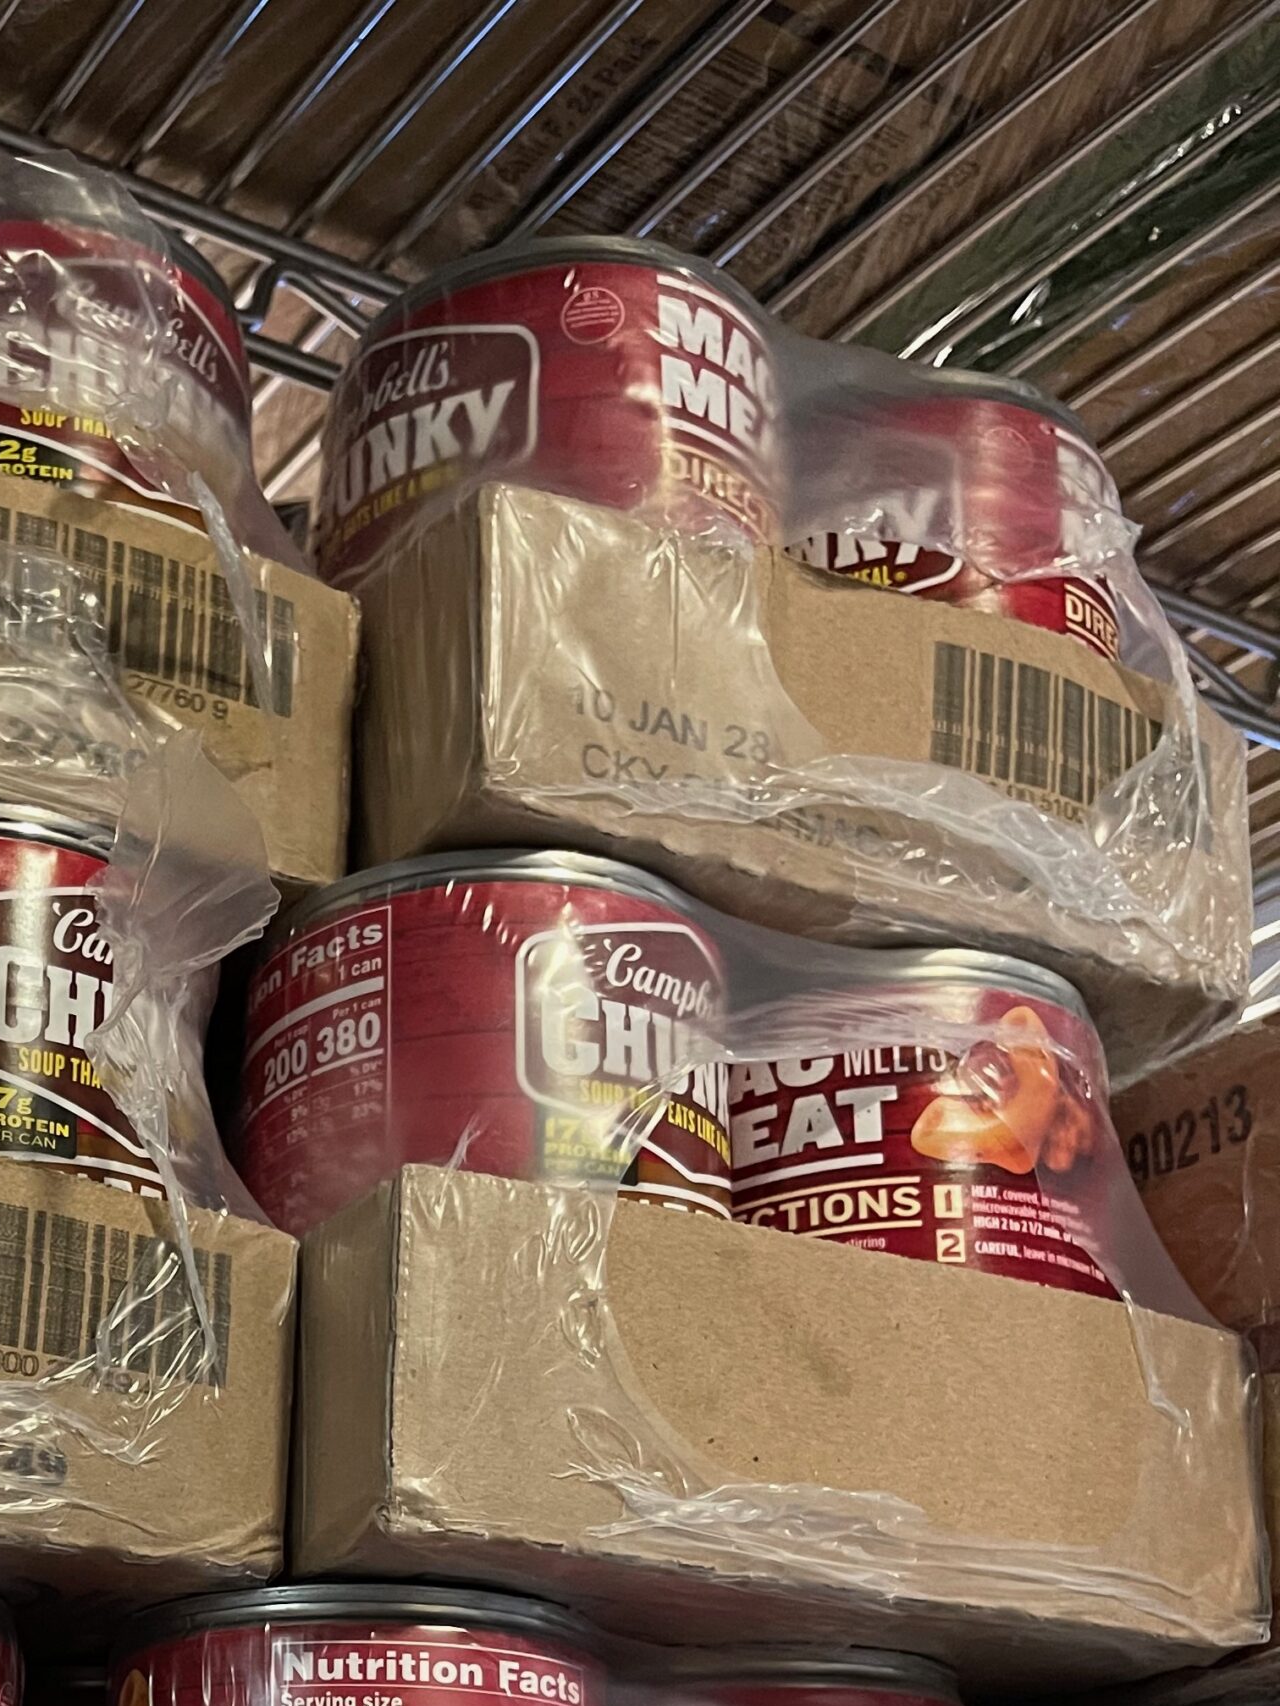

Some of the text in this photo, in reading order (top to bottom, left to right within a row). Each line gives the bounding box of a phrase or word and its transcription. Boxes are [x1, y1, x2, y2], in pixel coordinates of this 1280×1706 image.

[332, 379, 516, 508] UNKY
[628, 703, 707, 750] JAN
[724, 725, 772, 764] 28
[291, 922, 384, 977] Facts
[19, 1048, 67, 1078] SOUP
[264, 1039, 308, 1096] 200
[317, 1012, 382, 1063] 380
[18, 1132, 57, 1150] CAN
[734, 1085, 898, 1168] EAT
[282, 1650, 582, 1704] Nutrition Facts
